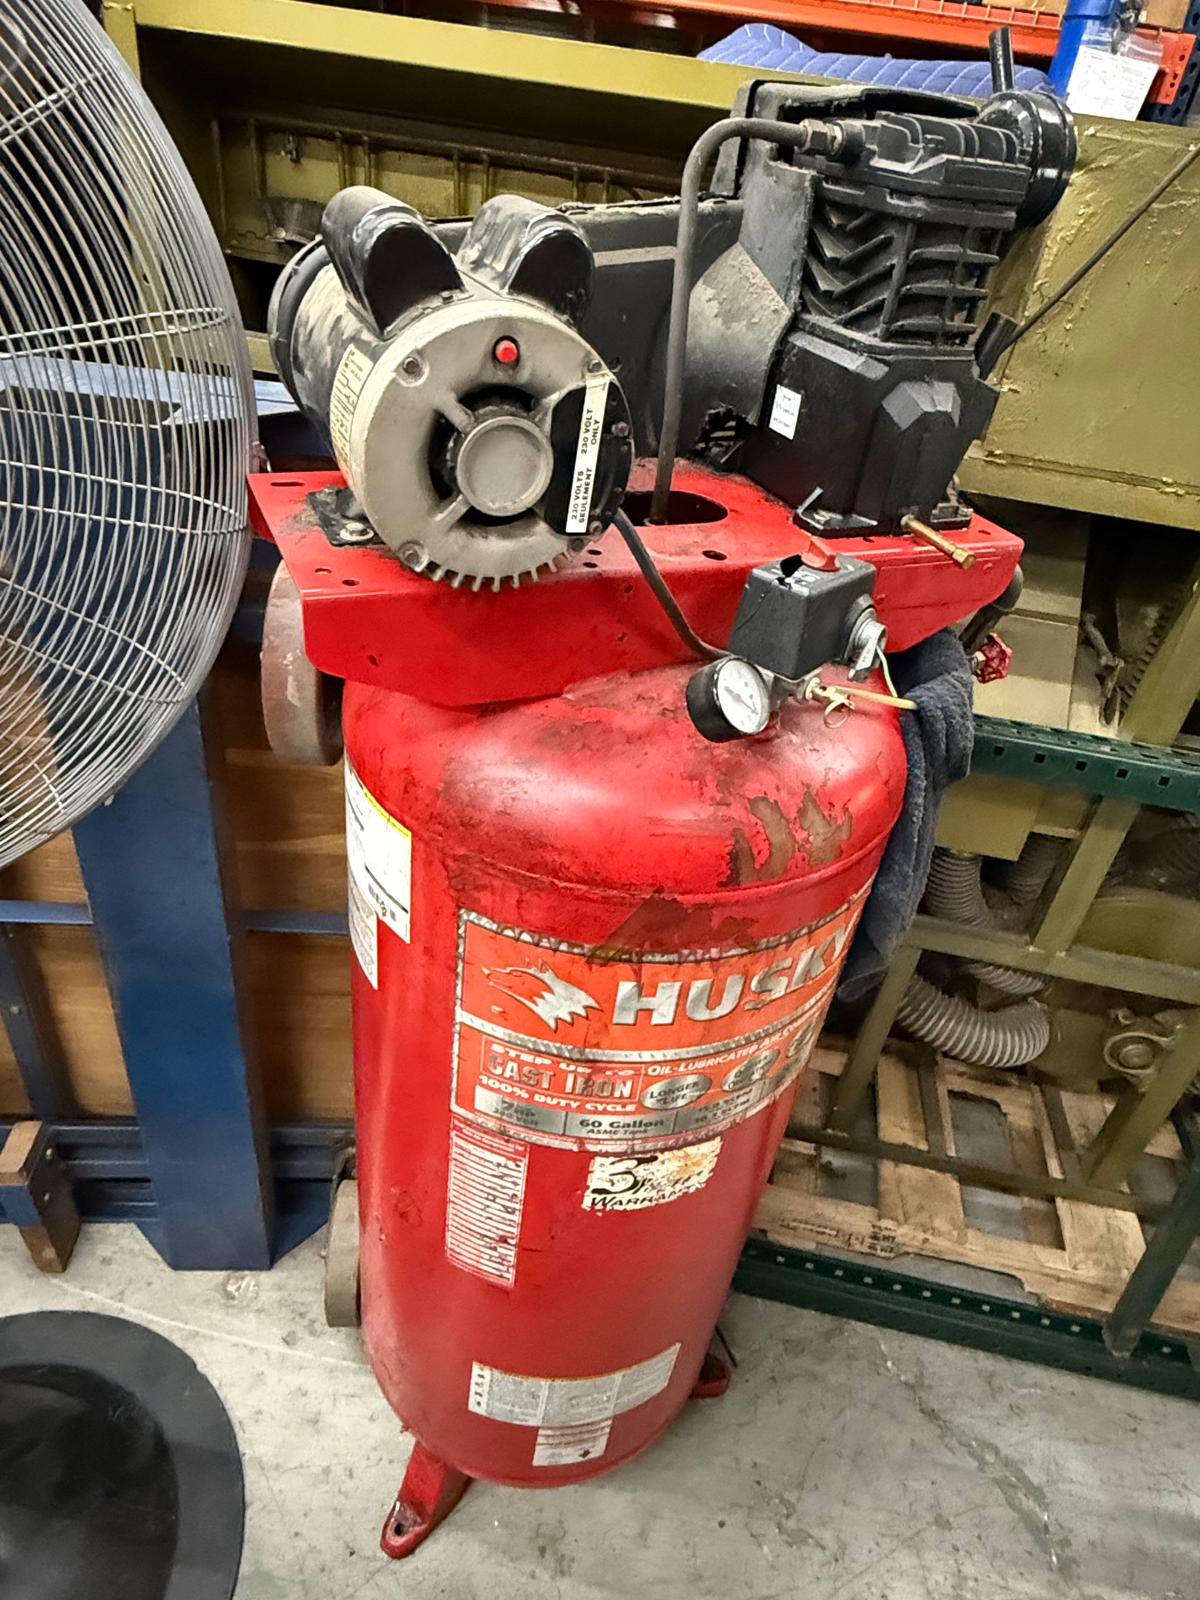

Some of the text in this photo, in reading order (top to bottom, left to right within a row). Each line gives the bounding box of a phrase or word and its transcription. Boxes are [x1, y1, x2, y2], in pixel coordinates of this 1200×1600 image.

[581, 408, 593, 454] 230 VOLT
[590, 419, 600, 445] ONLY
[571, 470, 584, 520] 230 VOLTS
[579, 468, 592, 523] SEULEMENT
[491, 1043, 552, 1065] STEP
[478, 1074, 636, 1112] 100% DUTY CYCLE
[487, 1052, 633, 1098] CAST IRON
[650, 1079, 699, 1099] LONGER
[579, 1119, 665, 1129] 60 Gallon
[591, 1155, 658, 1196] 3
